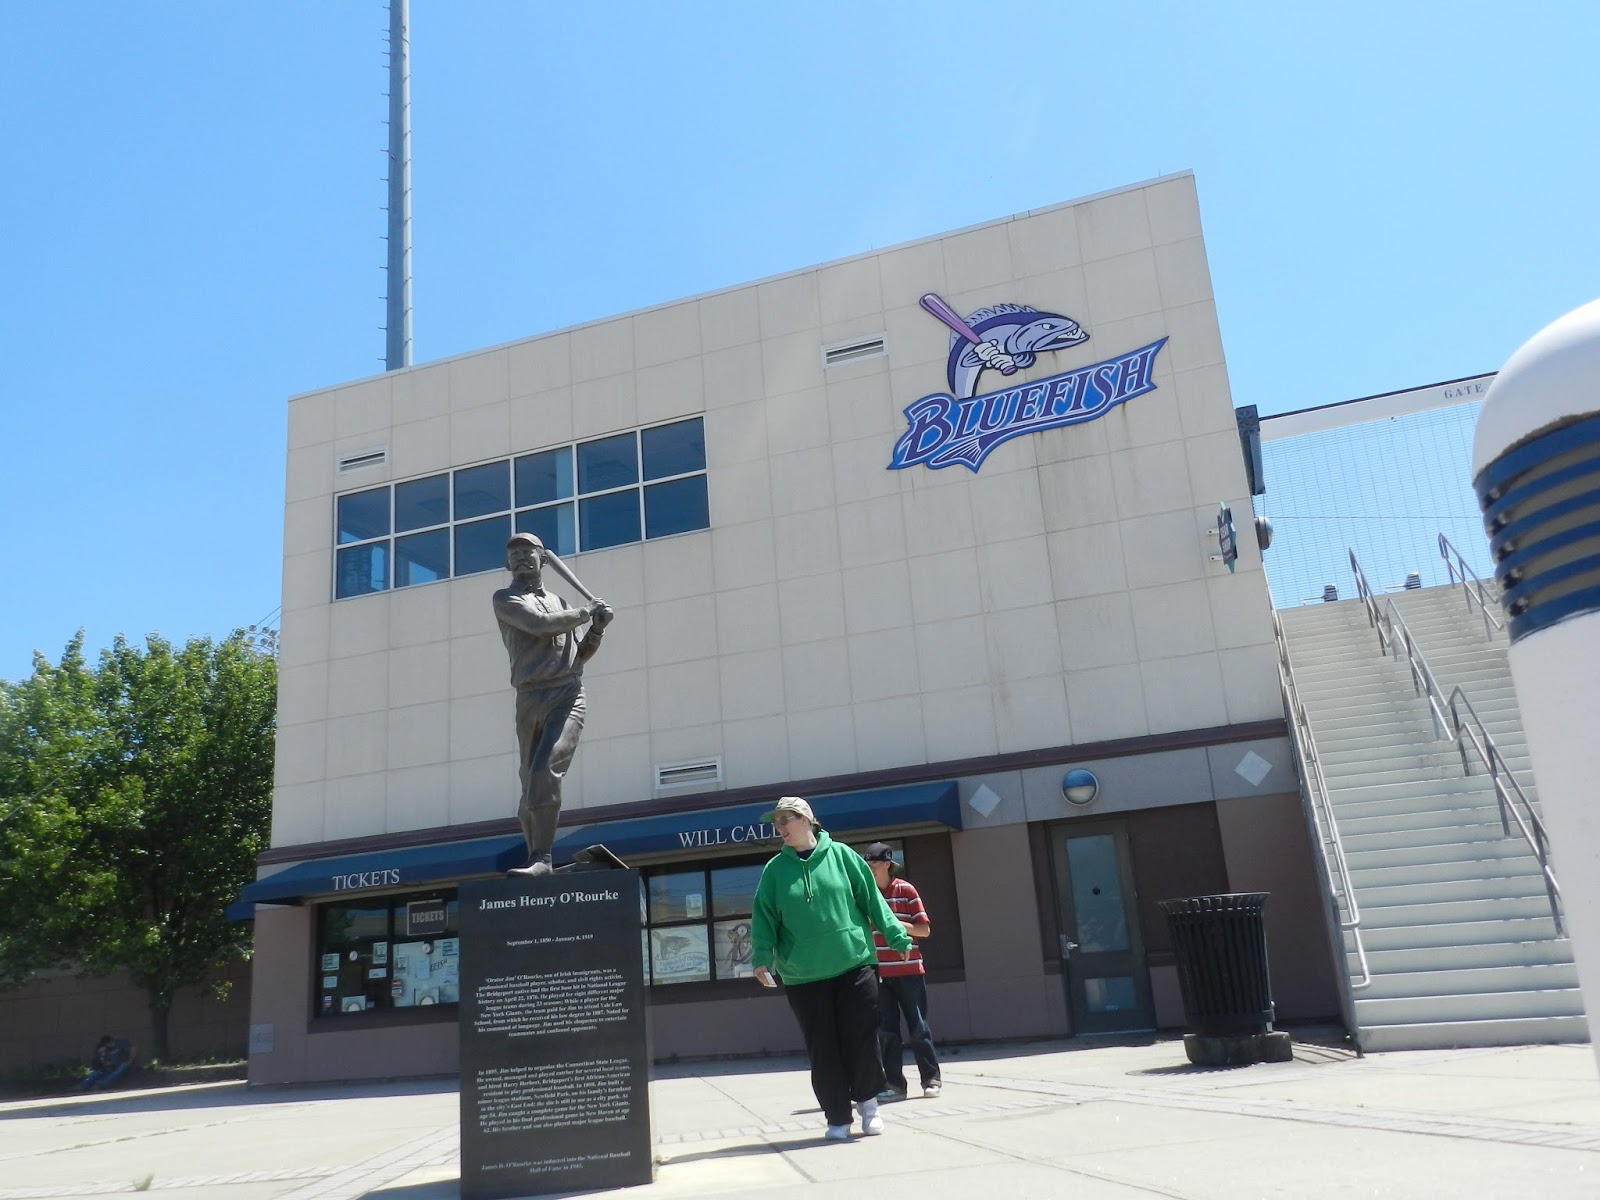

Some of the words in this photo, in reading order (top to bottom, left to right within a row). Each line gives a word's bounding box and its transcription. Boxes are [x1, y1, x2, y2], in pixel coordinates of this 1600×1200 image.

[1444, 383, 1484, 399] GATE
[678, 828, 727, 848] WILL
[731, 822, 783, 842] CALL
[332, 868, 400, 890] TICKETS
[479, 898, 516, 911] James
[520, 895, 556, 908] Henry
[560, 889, 619, 904] O'Rourke
[411, 909, 445, 924] TICKETS
[507, 939, 533, 947] September
[555, 935, 575, 943] January
[486, 990, 513, 998] Bridgeport
[609, 980, 626, 988] League
